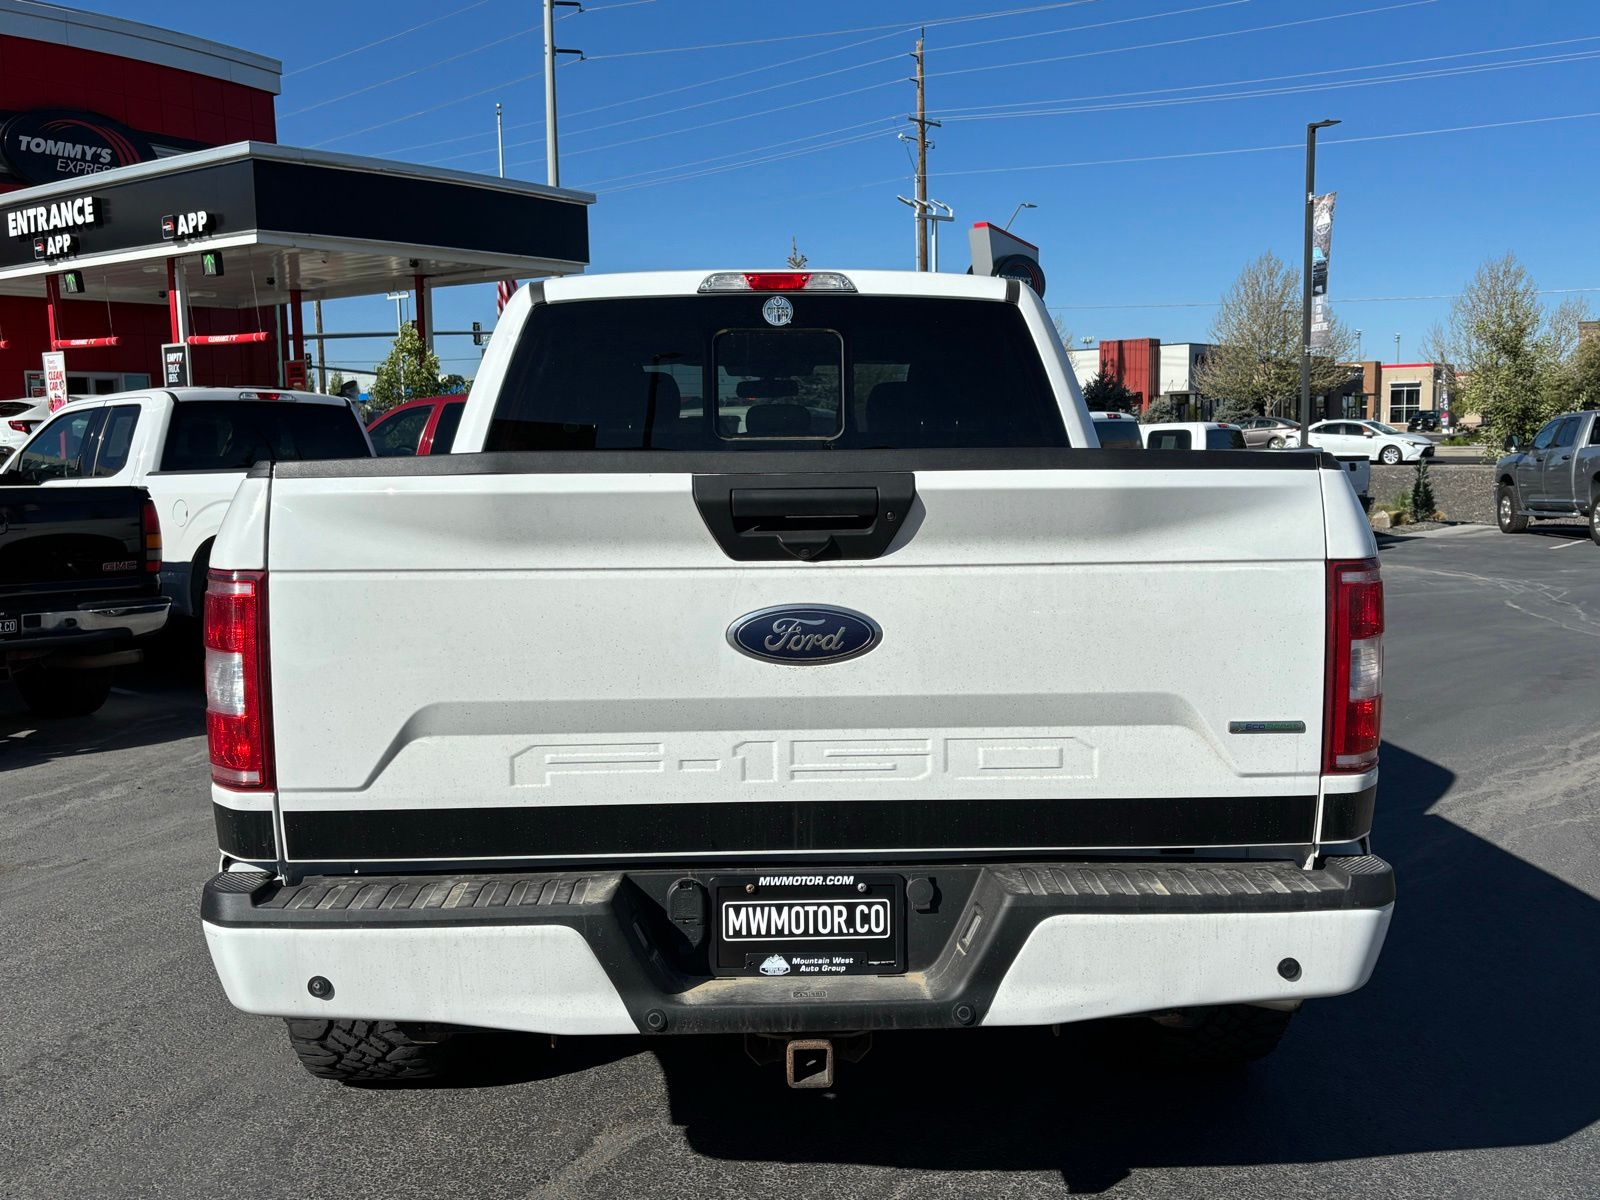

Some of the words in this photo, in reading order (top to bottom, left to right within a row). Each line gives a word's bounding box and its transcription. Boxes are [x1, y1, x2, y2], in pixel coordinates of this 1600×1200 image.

[18, 135, 112, 163] TOMMY'S
[57, 159, 117, 174] EXPRE
[8, 197, 94, 237] ENTRANCE
[177, 211, 207, 235] APP
[46, 233, 71, 256] APP
[166, 352, 183, 363] EMPTY
[48, 371, 64, 381] CLEAN
[102, 560, 137, 572] GMC
[764, 618, 844, 652] Ford
[510, 737, 1100, 788] F-150
[758, 875, 854, 887] MWMOTOR.COM
[728, 904, 884, 935] MWMOTOR.CO
[792, 957, 830, 965] Mountain
[832, 956, 854, 964] West
[821, 964, 846, 973] Group
